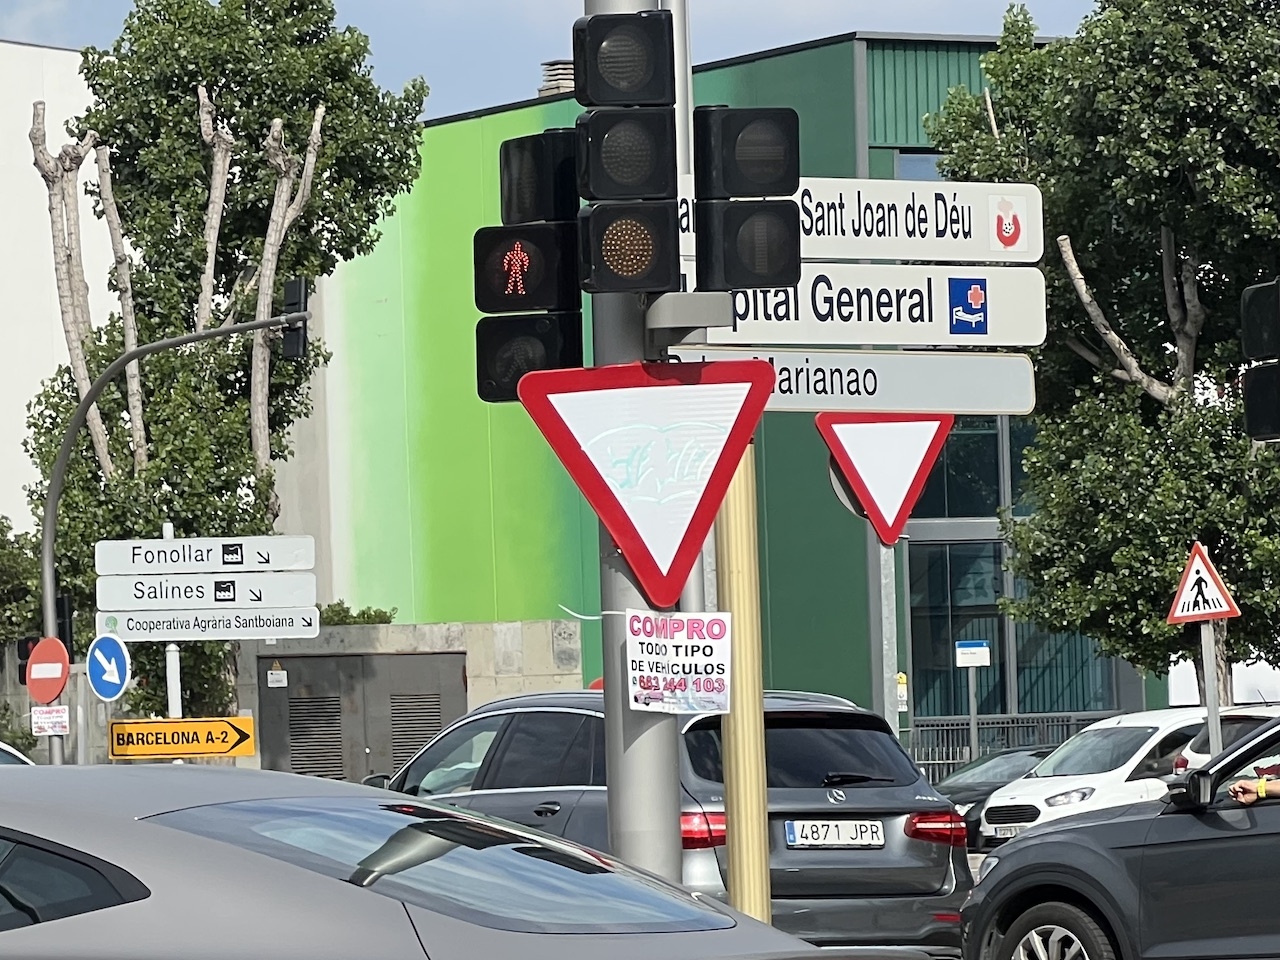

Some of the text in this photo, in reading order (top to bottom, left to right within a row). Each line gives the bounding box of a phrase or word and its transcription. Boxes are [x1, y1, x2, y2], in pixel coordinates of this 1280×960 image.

[801, 188, 972, 240] Sant Joan de Déu
[732, 274, 934, 332] pital General
[753, 355, 878, 396] arianao
[131, 544, 213, 564] Fonollar
[133, 579, 205, 600] Salines
[126, 614, 294, 634] Cooperativa Agrària Santboiana
[629, 615, 727, 640] COMPRO
[638, 641, 714, 657] TODO TIPO
[631, 659, 725, 675] DE VEHÍCULOS
[692, 677, 726, 693] 103
[116, 730, 229, 746] BARCELONA A-2
[800, 824, 880, 841] 4871 JPR
